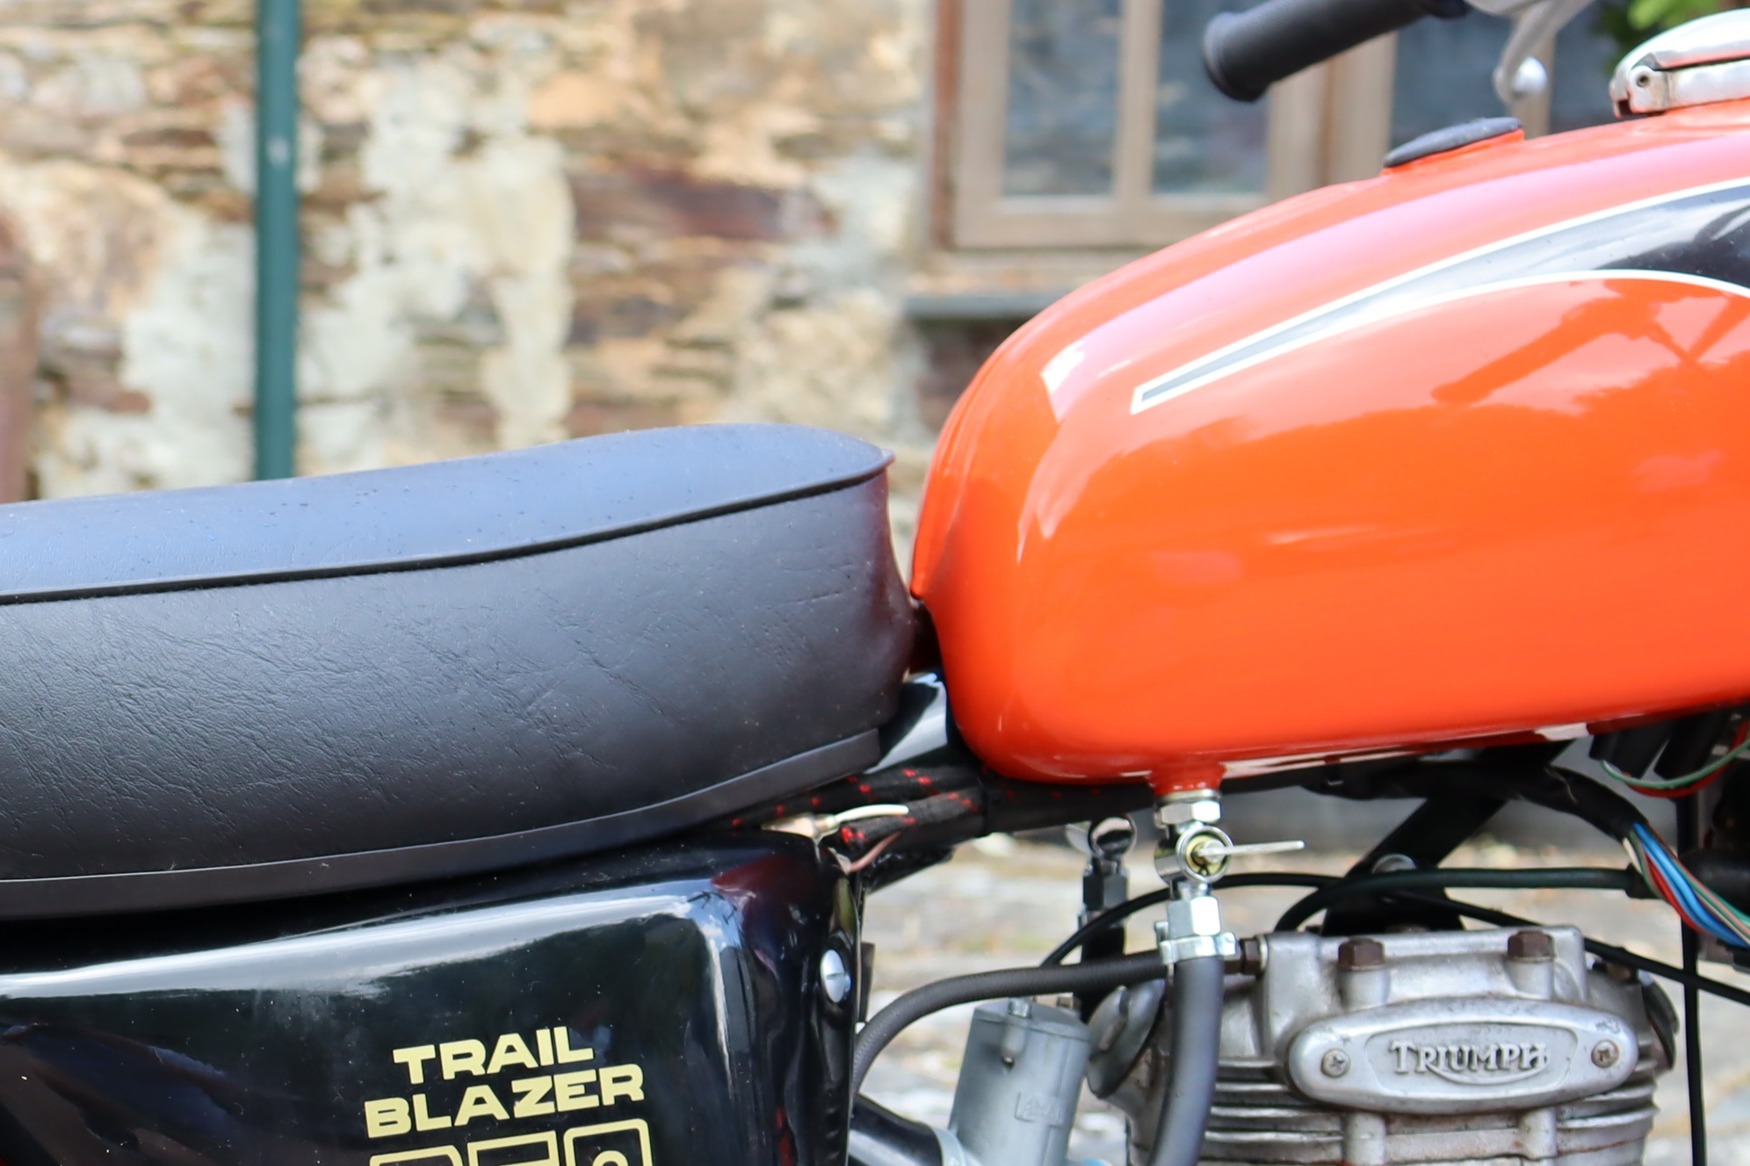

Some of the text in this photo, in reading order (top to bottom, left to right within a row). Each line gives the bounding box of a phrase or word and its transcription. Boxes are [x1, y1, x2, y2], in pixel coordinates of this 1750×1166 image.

[393, 1026, 594, 1084] TRAIL
[1388, 1039, 1548, 1085] TRIUMPH
[364, 1064, 645, 1138] BLAZER
